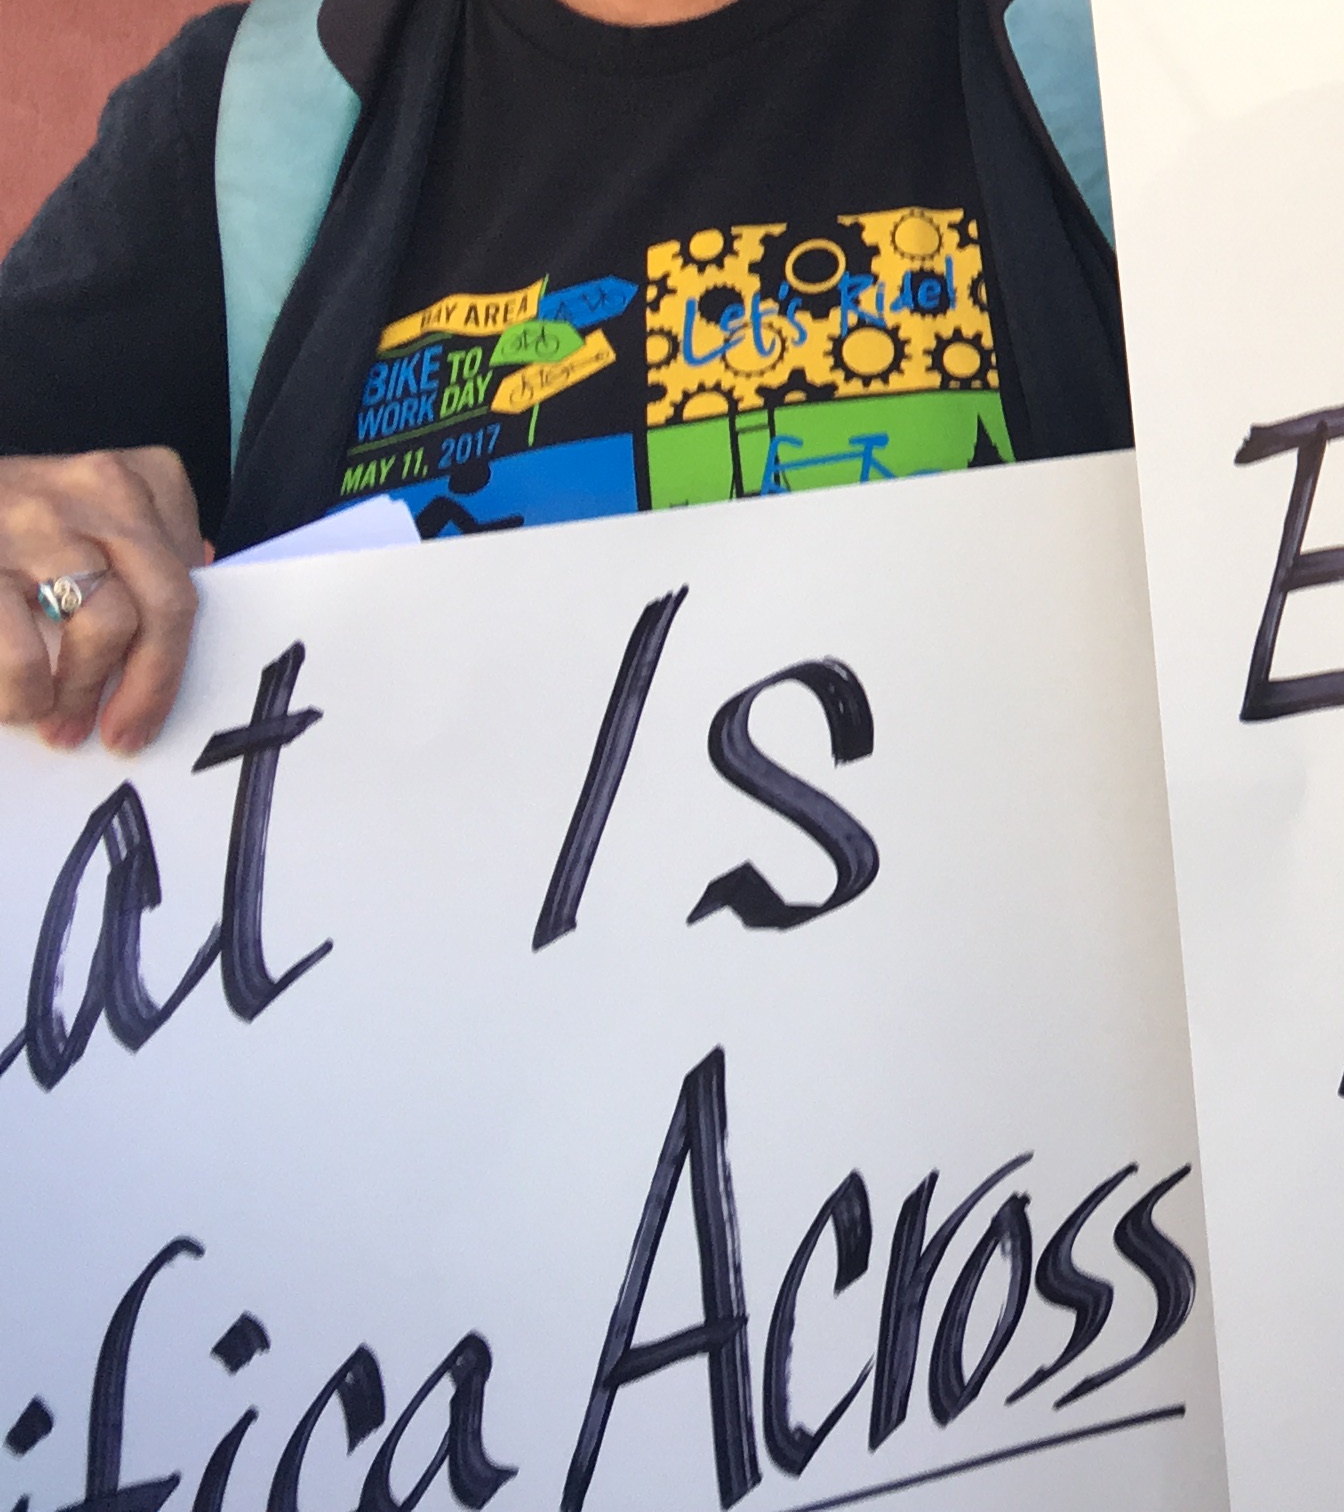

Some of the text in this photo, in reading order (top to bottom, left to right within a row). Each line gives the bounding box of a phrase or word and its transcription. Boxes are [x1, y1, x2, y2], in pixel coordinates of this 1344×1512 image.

[463, 295, 528, 327] AREA
[682, 281, 808, 367] Let's
[357, 370, 493, 442] WORK DAY
[361, 344, 443, 407] BIKE
[447, 346, 482, 384] TO
[340, 422, 501, 496] MAY 11, 2017
[0, 584, 880, 1090] at Is
[560, 1045, 1196, 1512] Across
